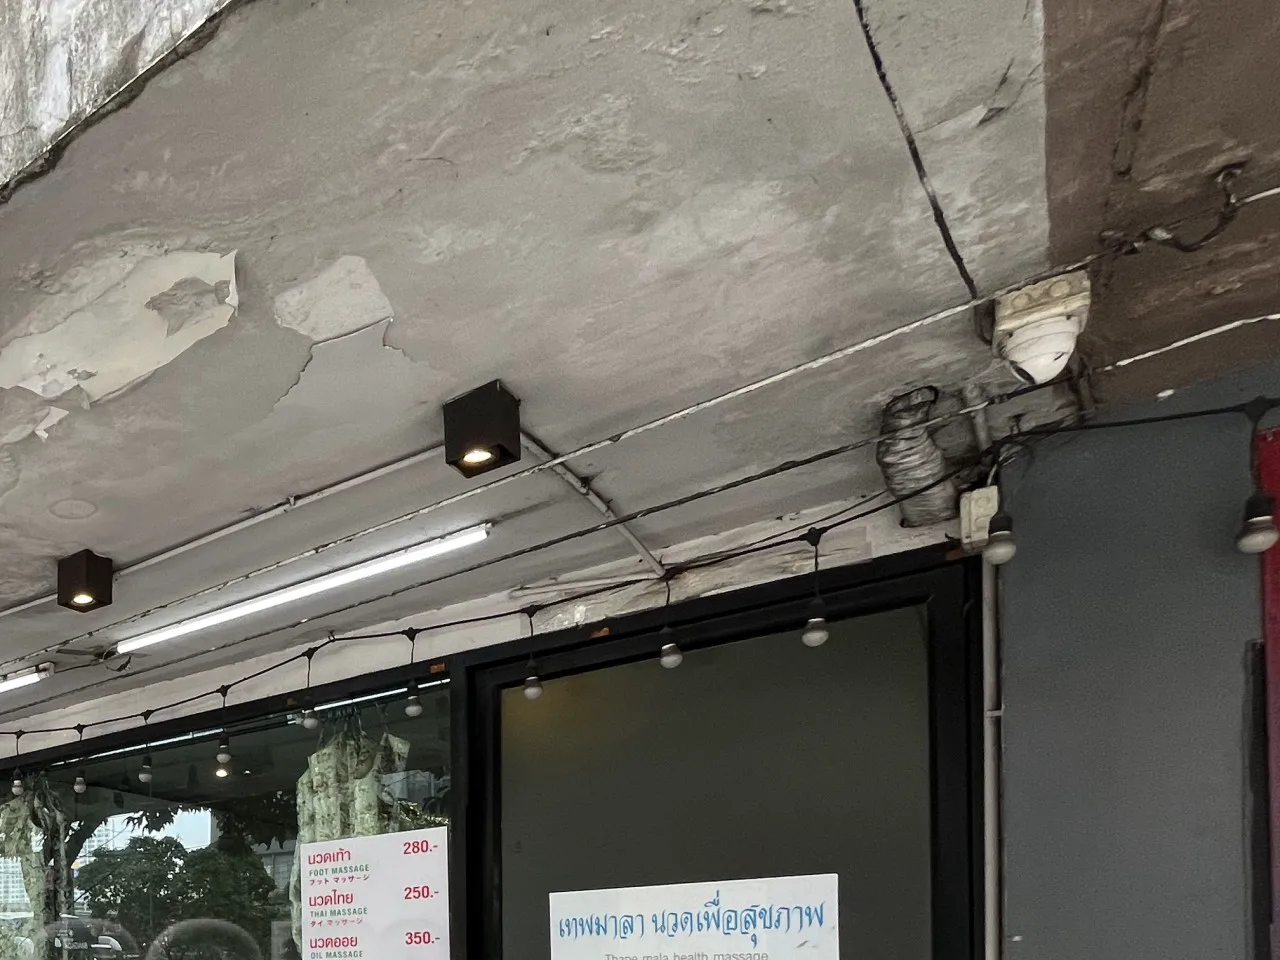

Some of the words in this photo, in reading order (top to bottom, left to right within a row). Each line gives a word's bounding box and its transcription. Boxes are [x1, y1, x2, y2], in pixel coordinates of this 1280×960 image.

[308, 848, 351, 865] นวดเท้า
[403, 840, 438, 855] 280.-
[309, 868, 329, 876] FOOT
[331, 864, 370, 875] MASSAGE
[309, 889, 354, 907] นวดไทย
[404, 885, 439, 900] 250.-
[310, 910, 328, 918] THAI
[330, 907, 368, 917] MASSAGE
[559, 912, 645, 940] เทพมาลา
[652, 890, 826, 949] นวดเพื่อสุขภาพ
[310, 936, 358, 949] นวดออย
[405, 931, 441, 945] 350.-
[310, 951, 323, 960] OIL
[326, 950, 363, 959] MASSAGE
